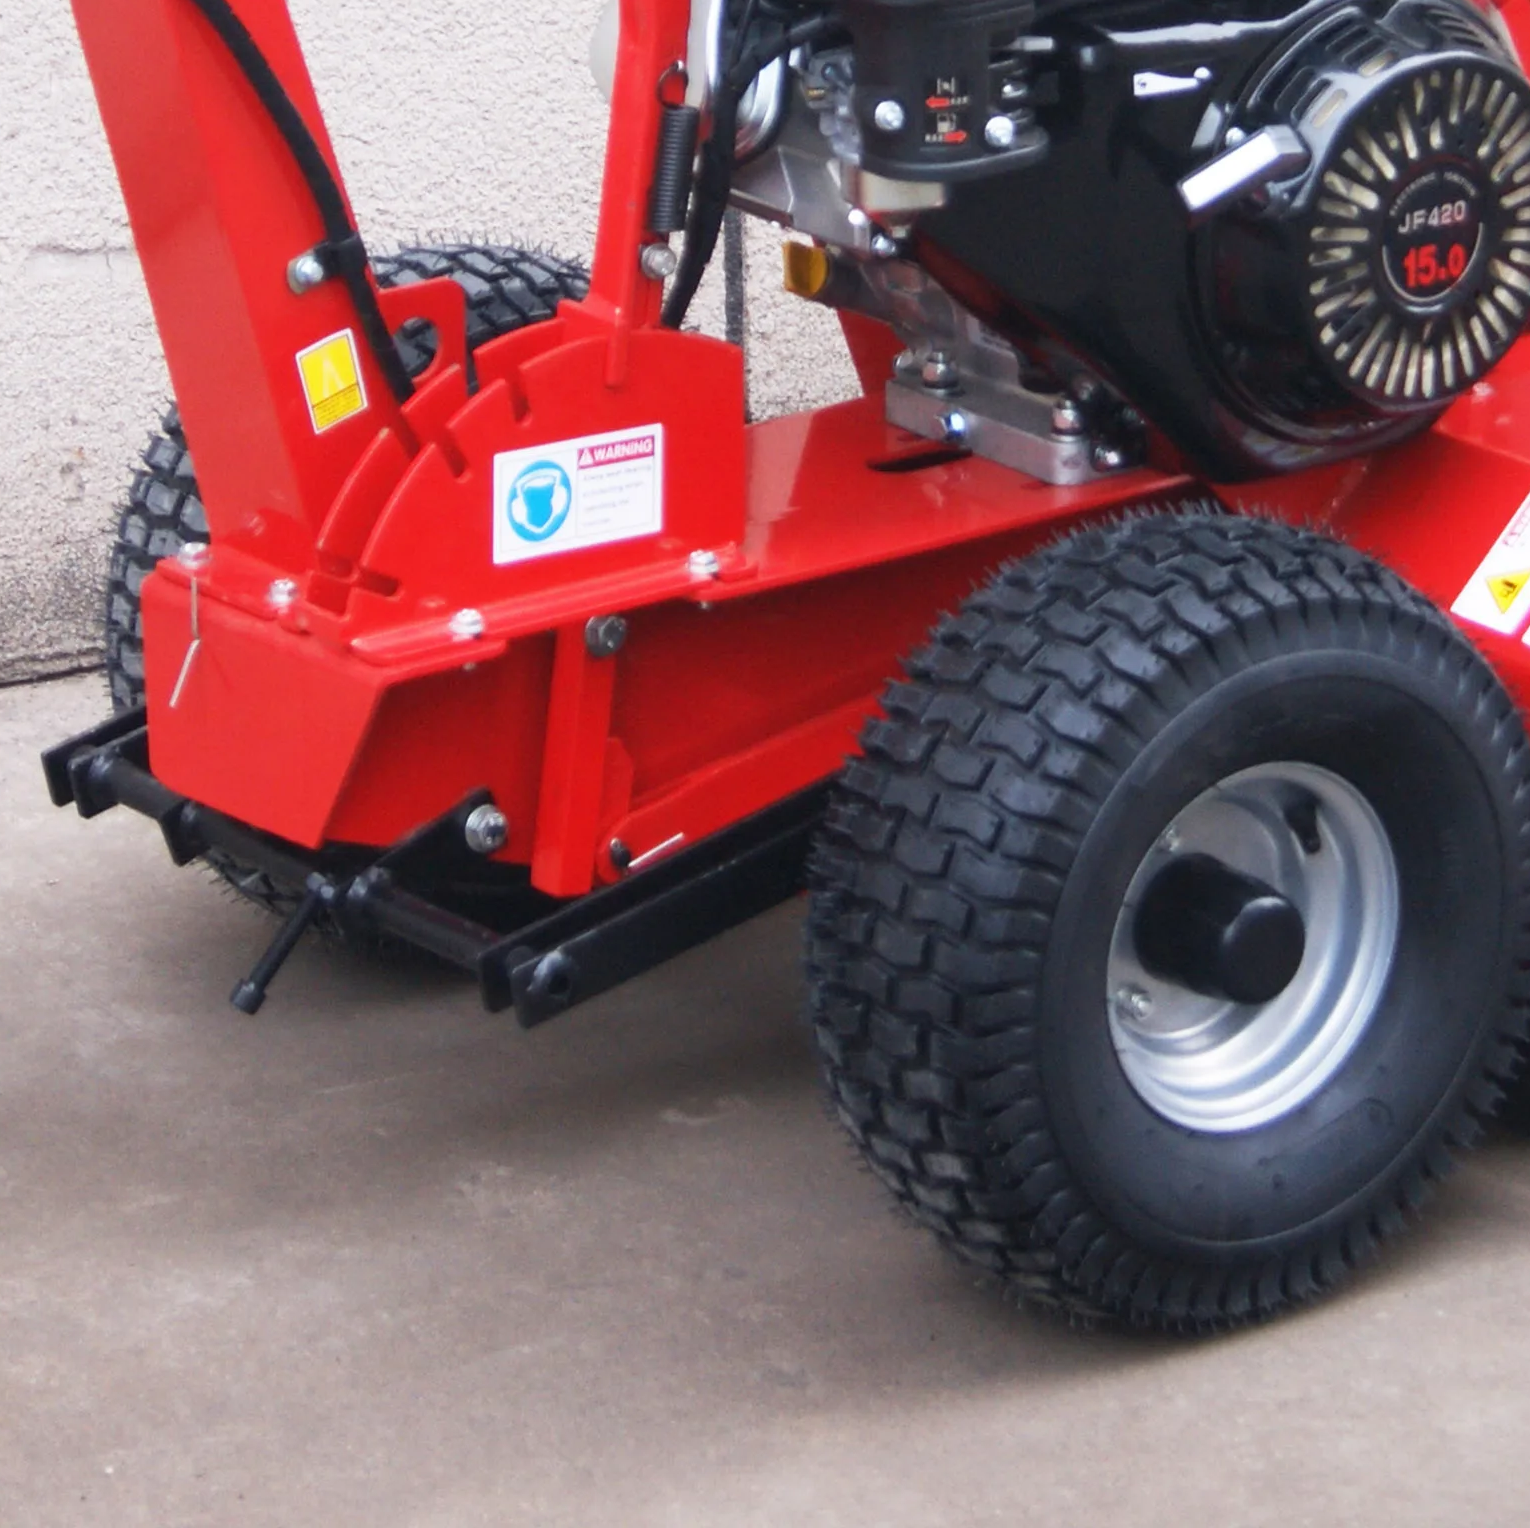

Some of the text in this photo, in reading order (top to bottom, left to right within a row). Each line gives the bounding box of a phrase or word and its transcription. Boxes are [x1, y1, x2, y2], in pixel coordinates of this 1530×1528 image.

[1398, 200, 1466, 233] JF420
[1403, 243, 1466, 287] 15.0
[594, 438, 652, 460] WARNING
